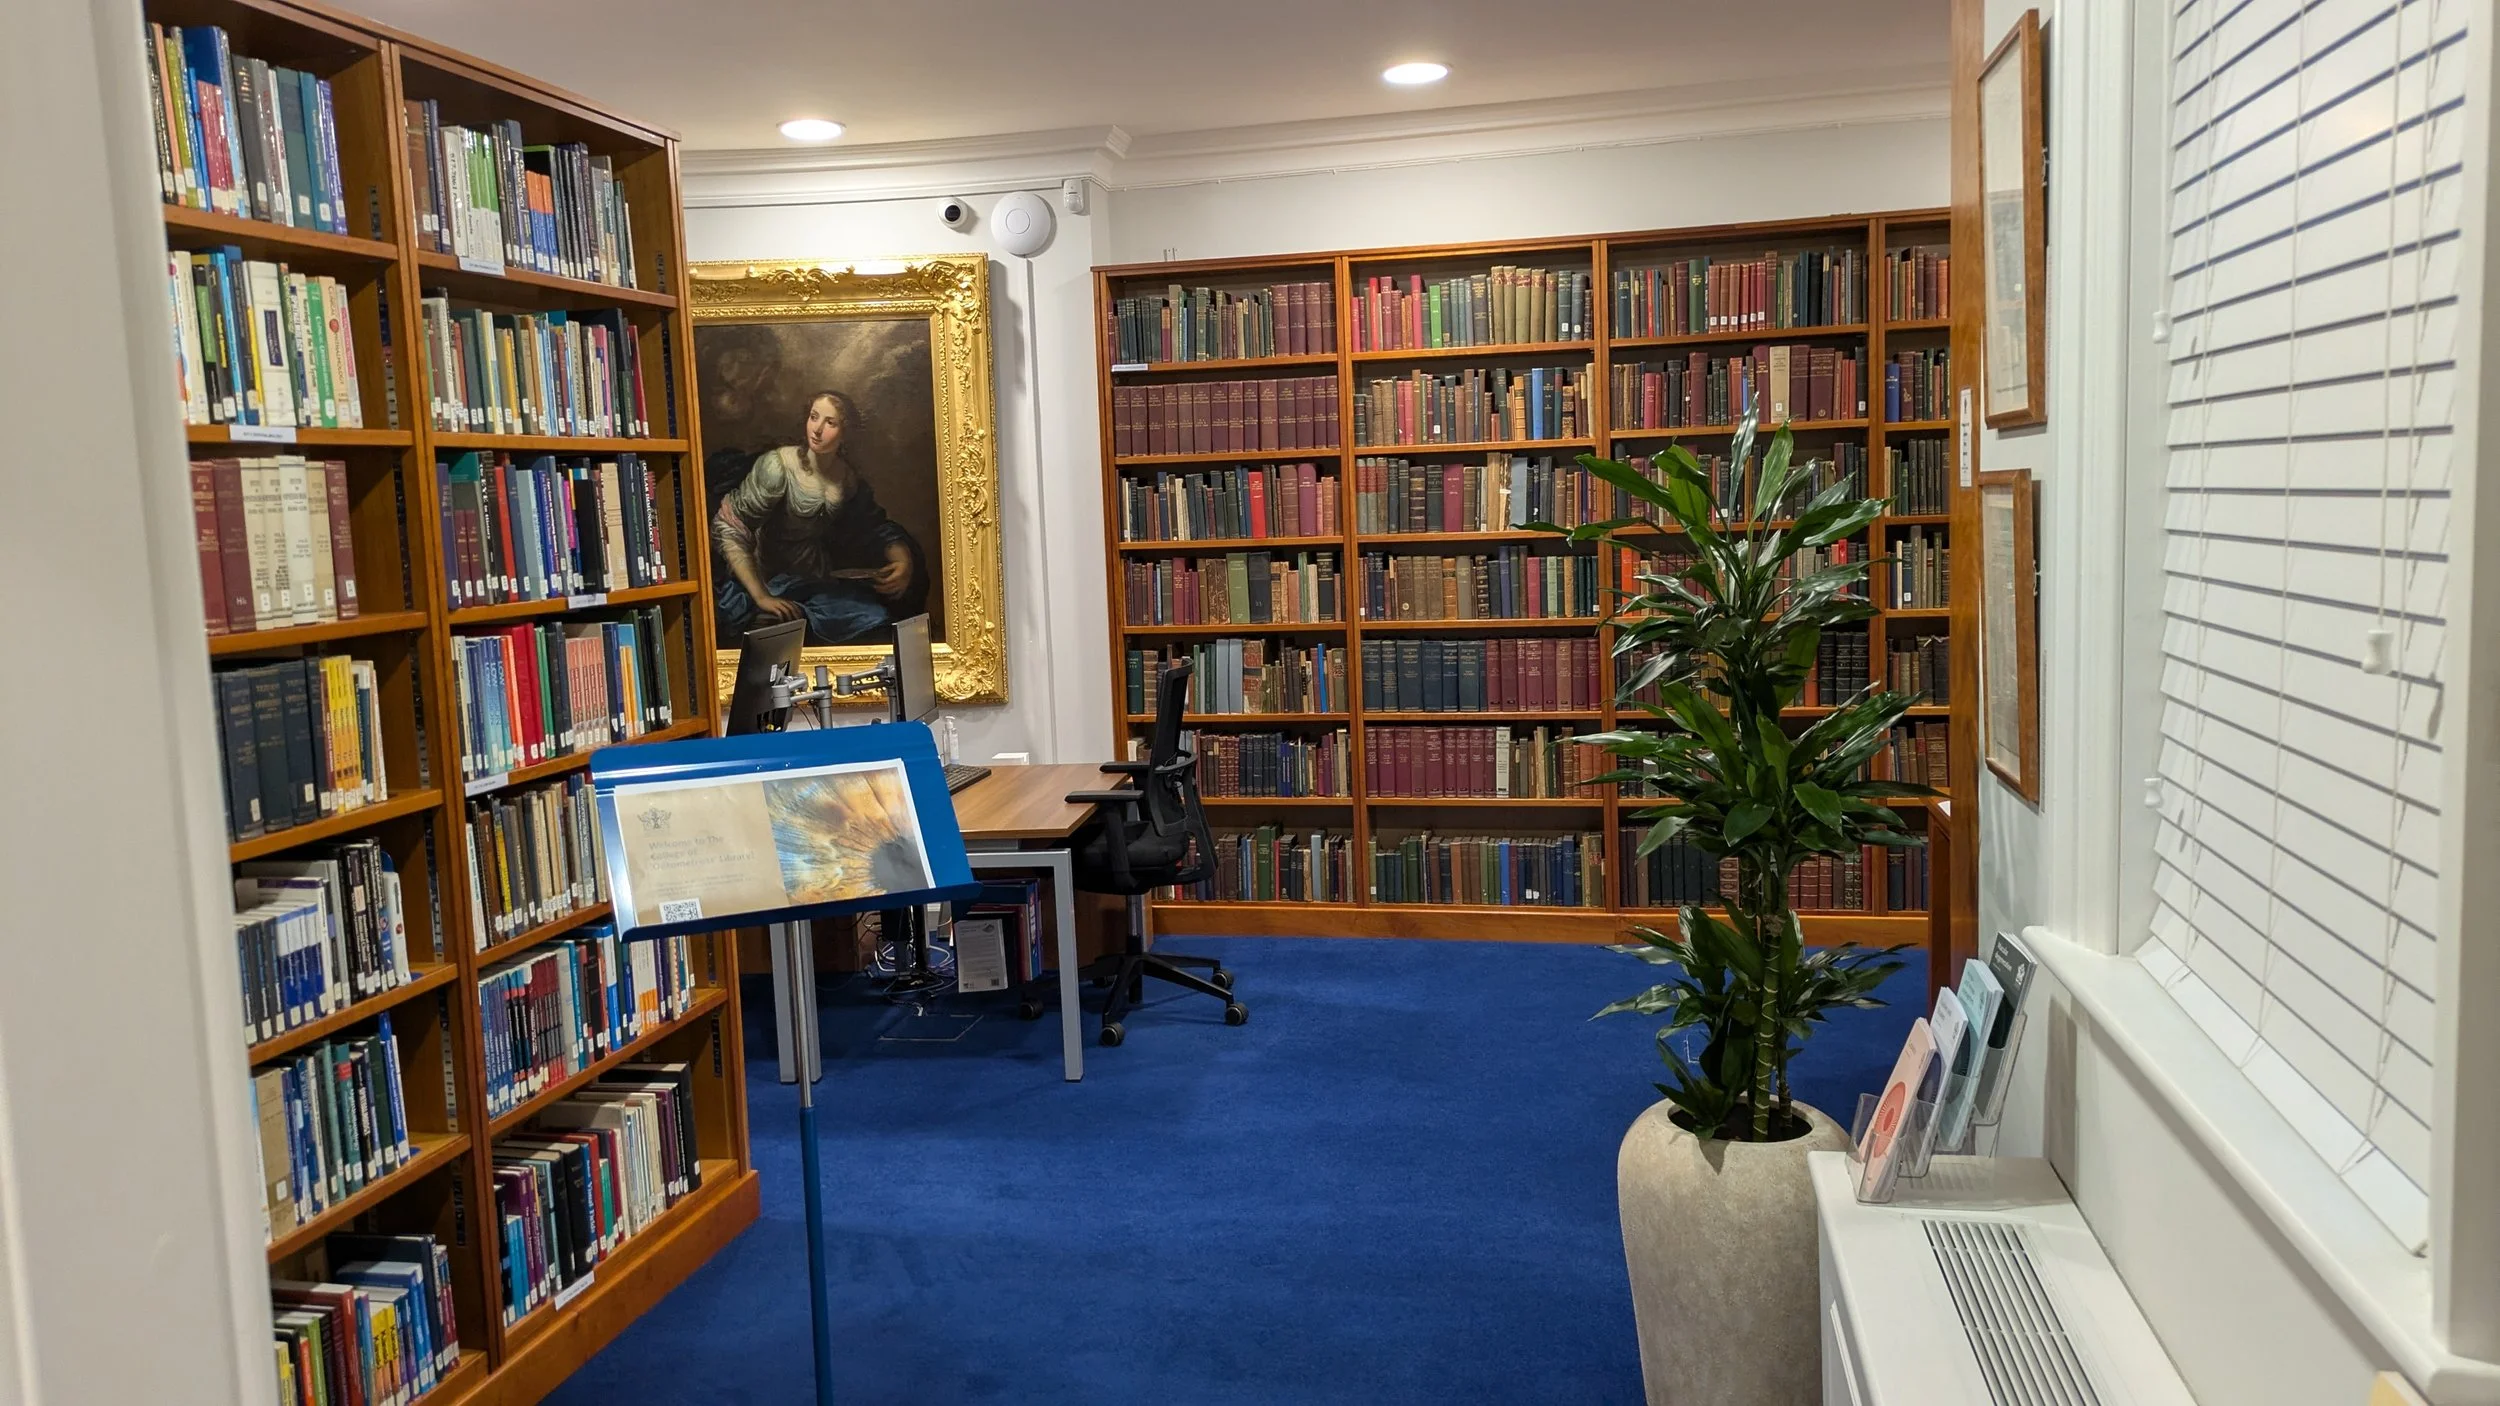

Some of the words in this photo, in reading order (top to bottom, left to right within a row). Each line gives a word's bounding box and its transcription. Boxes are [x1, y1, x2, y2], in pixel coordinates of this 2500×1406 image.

[645, 493, 653, 542] IMMUNOLOGY
[648, 839, 692, 850] Welcome
[706, 835, 724, 846] The
[650, 851, 686, 862] College
[688, 849, 698, 857] of
[719, 850, 755, 863] Library!
